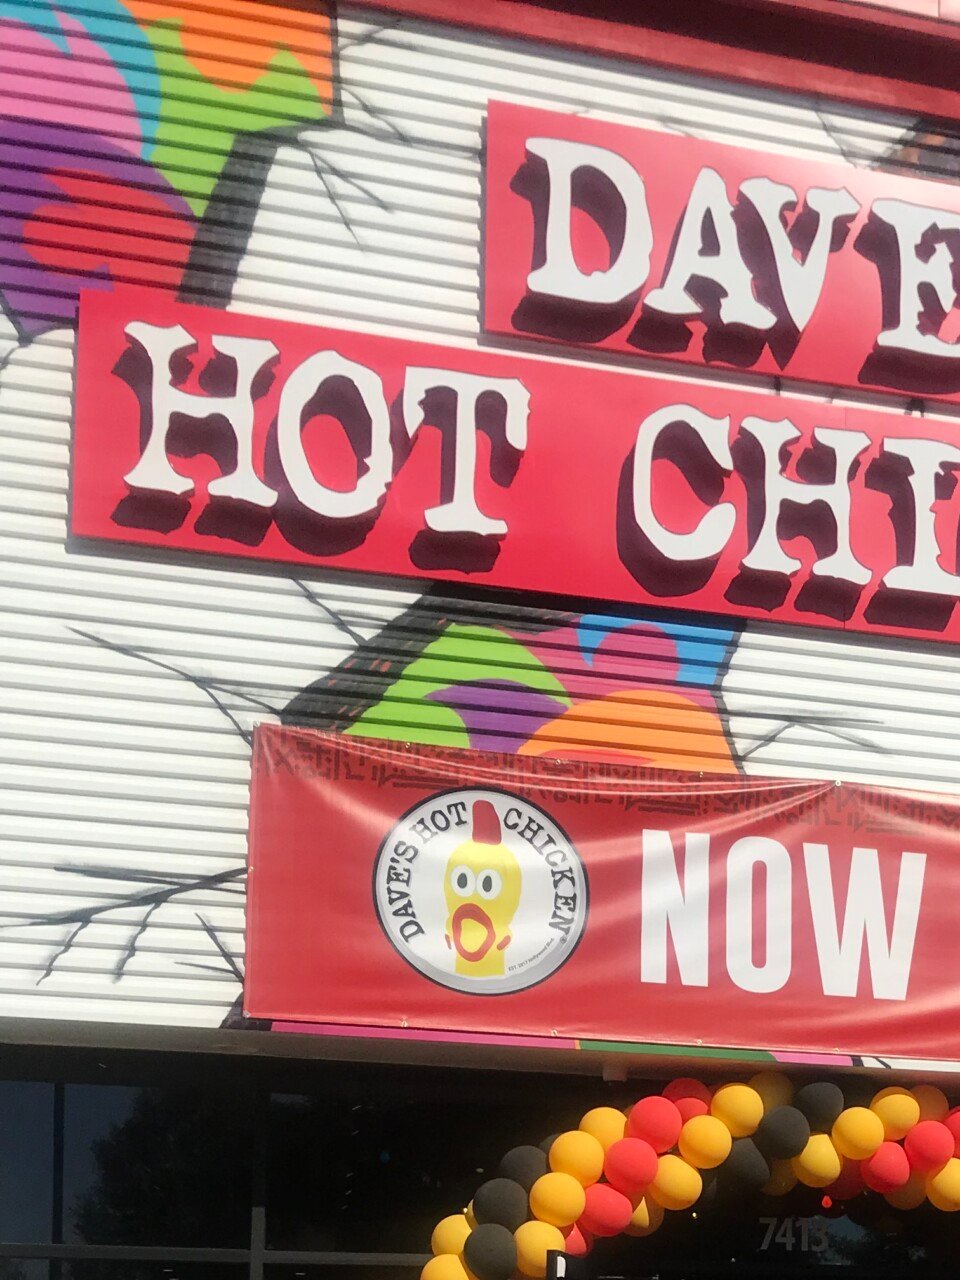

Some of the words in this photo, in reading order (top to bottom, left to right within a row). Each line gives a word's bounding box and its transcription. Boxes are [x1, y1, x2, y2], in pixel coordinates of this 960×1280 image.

[123, 321, 531, 536] HOT
[387, 841, 425, 943] DAVE'S
[409, 801, 468, 845] HOT
[503, 807, 577, 936] CHICKEN
[640, 830, 927, 1000] NOW
